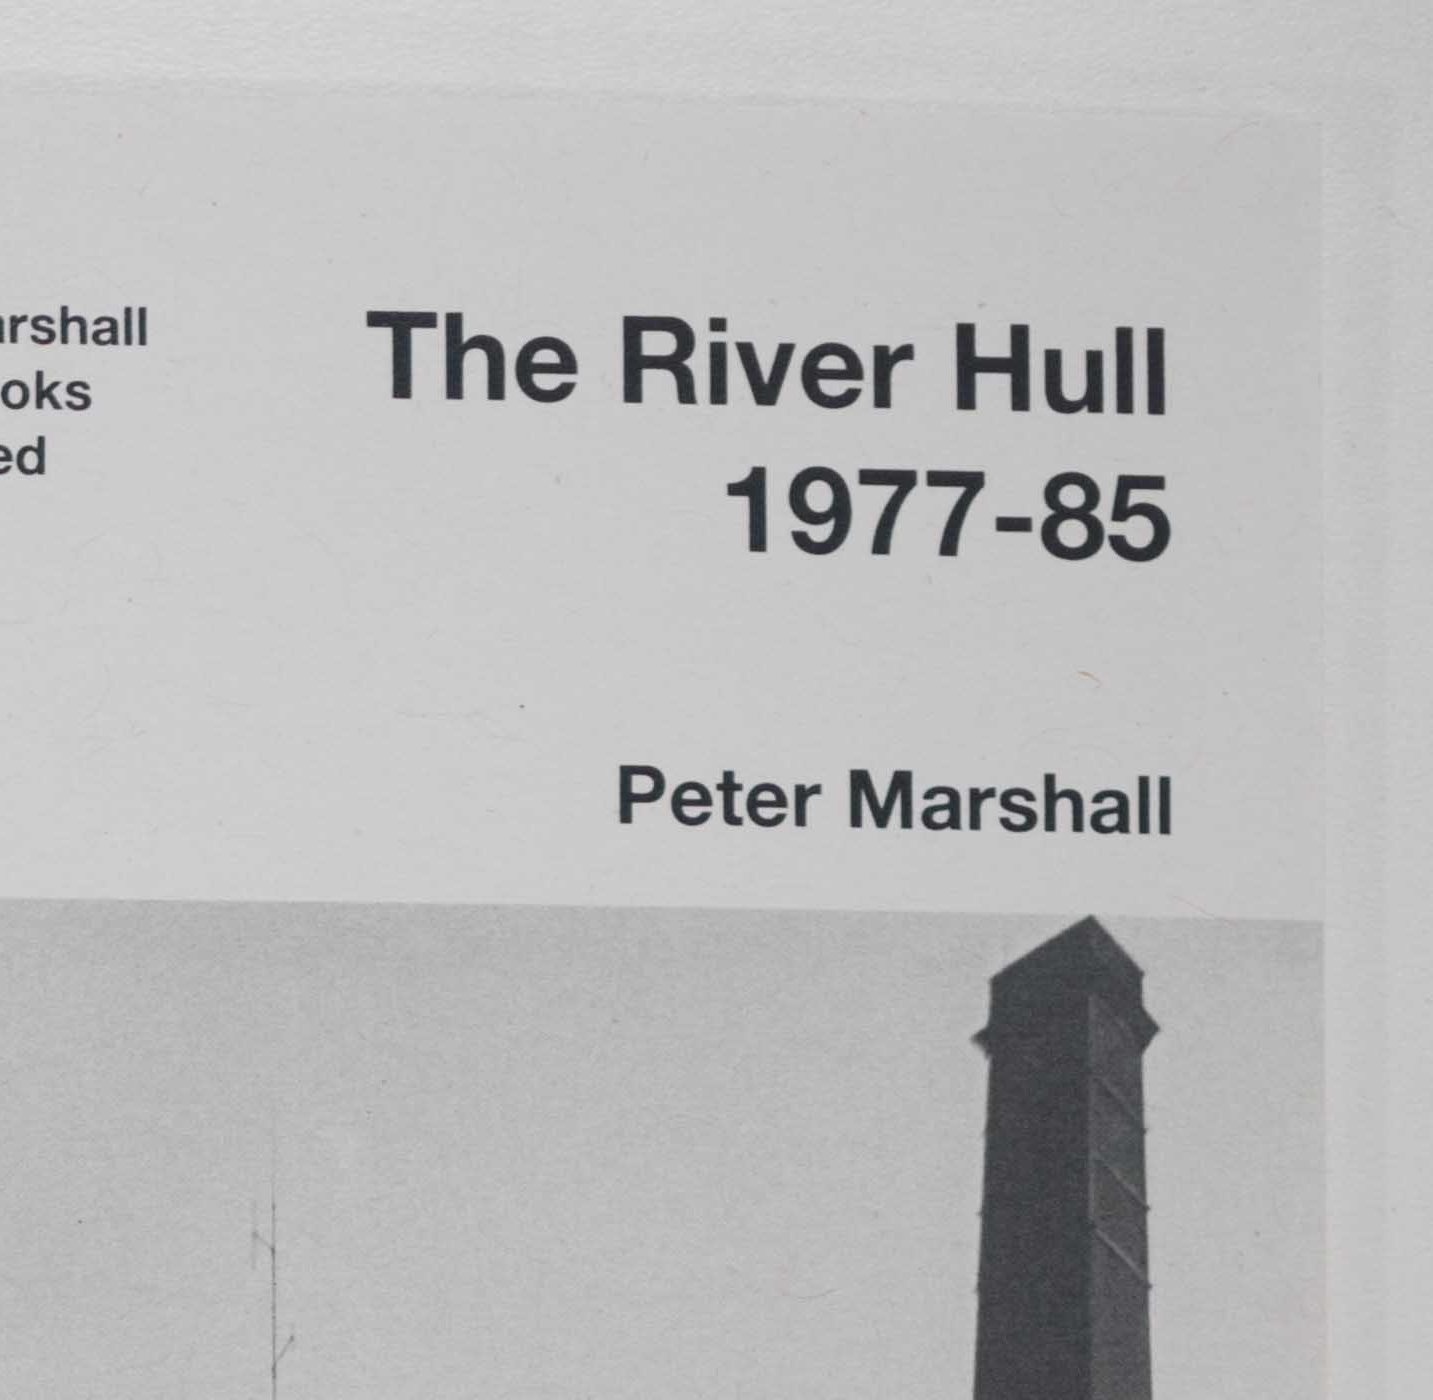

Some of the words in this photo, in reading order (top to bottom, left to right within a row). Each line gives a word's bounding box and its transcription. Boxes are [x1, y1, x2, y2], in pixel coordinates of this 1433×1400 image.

[365, 310, 579, 404] The
[622, 315, 915, 410] River
[955, 322, 1166, 416] Hull
[726, 465, 1172, 563] 1977-85
[618, 764, 823, 828] Peter
[849, 768, 1172, 836] Marshall
